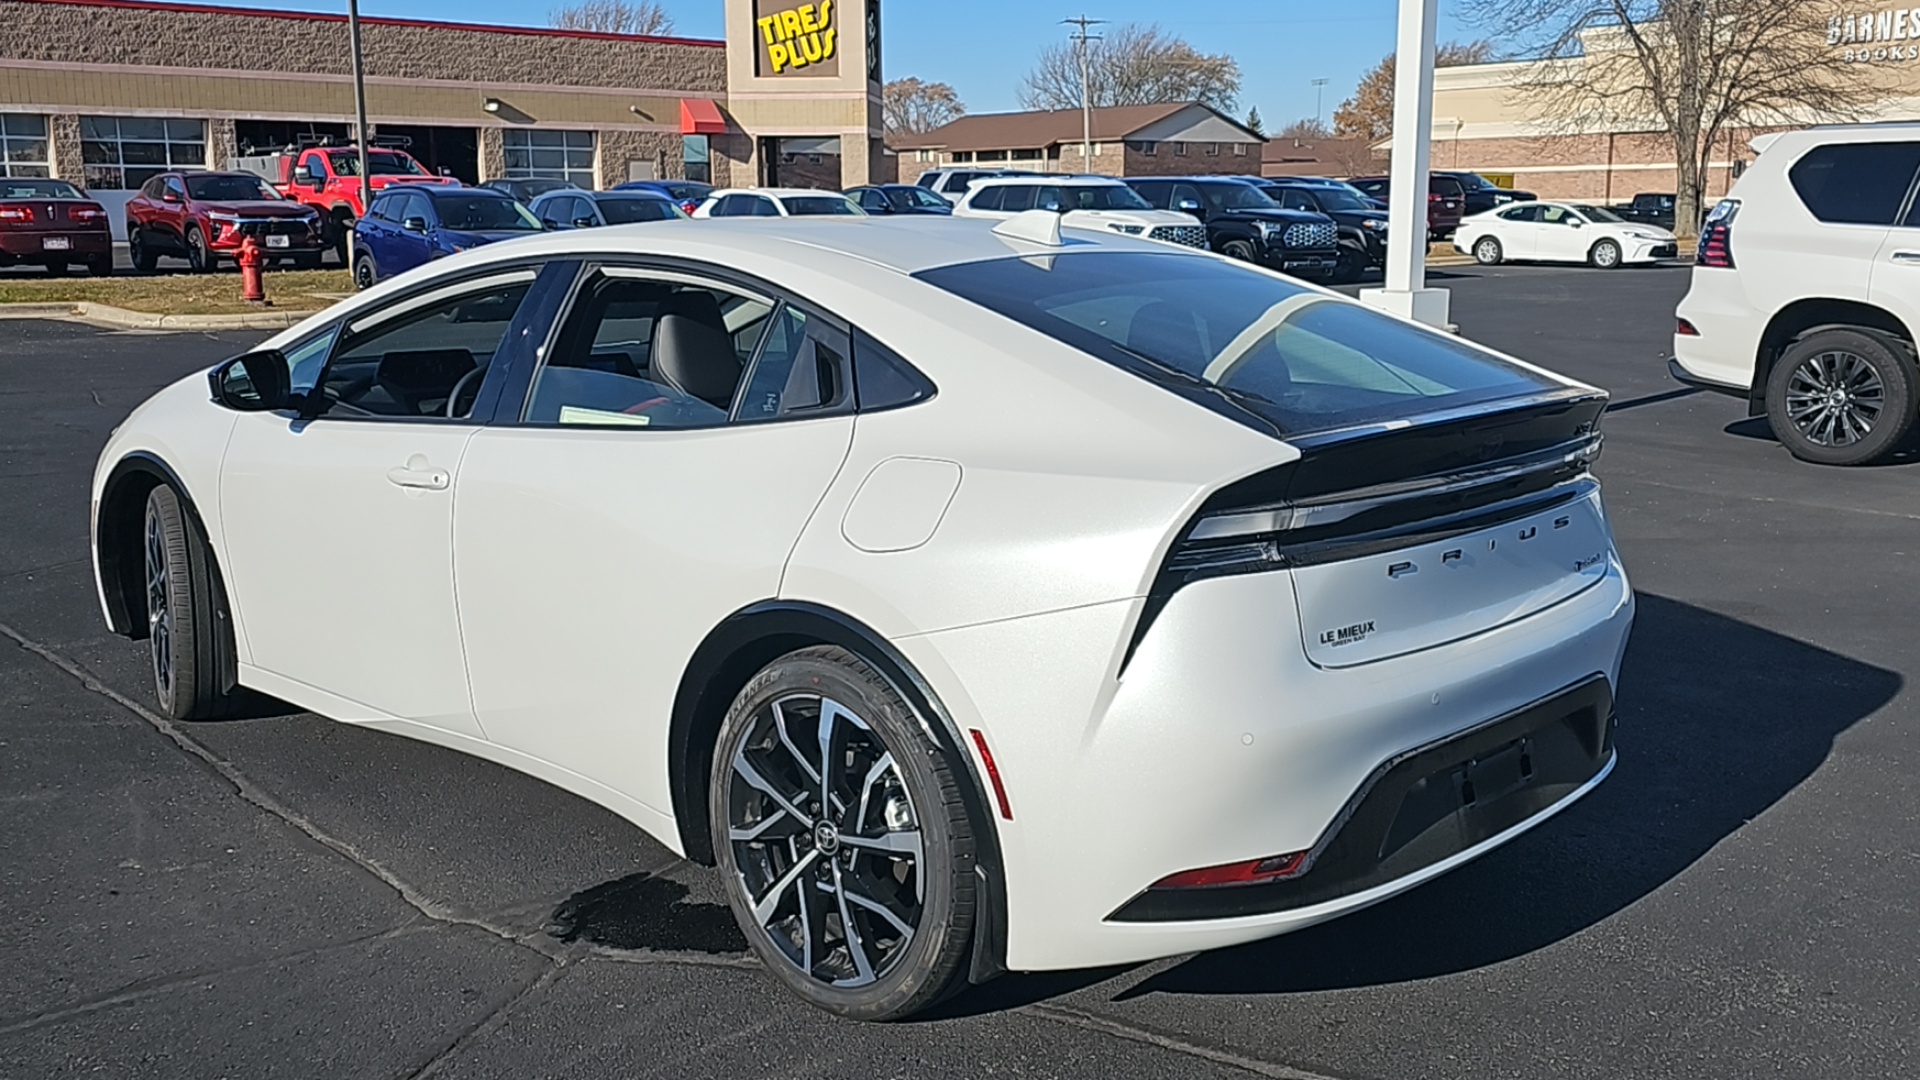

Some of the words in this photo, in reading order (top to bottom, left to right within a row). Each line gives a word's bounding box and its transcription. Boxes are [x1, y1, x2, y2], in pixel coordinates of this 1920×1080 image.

[757, 0, 832, 45] TIRES
[1827, 8, 1920, 45] BARNES
[768, 28, 836, 73] PLUS
[1844, 45, 1918, 63] BOOKS
[1388, 515, 1570, 577] PRIUS
[1320, 630, 1335, 644] LE
[1337, 620, 1375, 640] MIEUX
